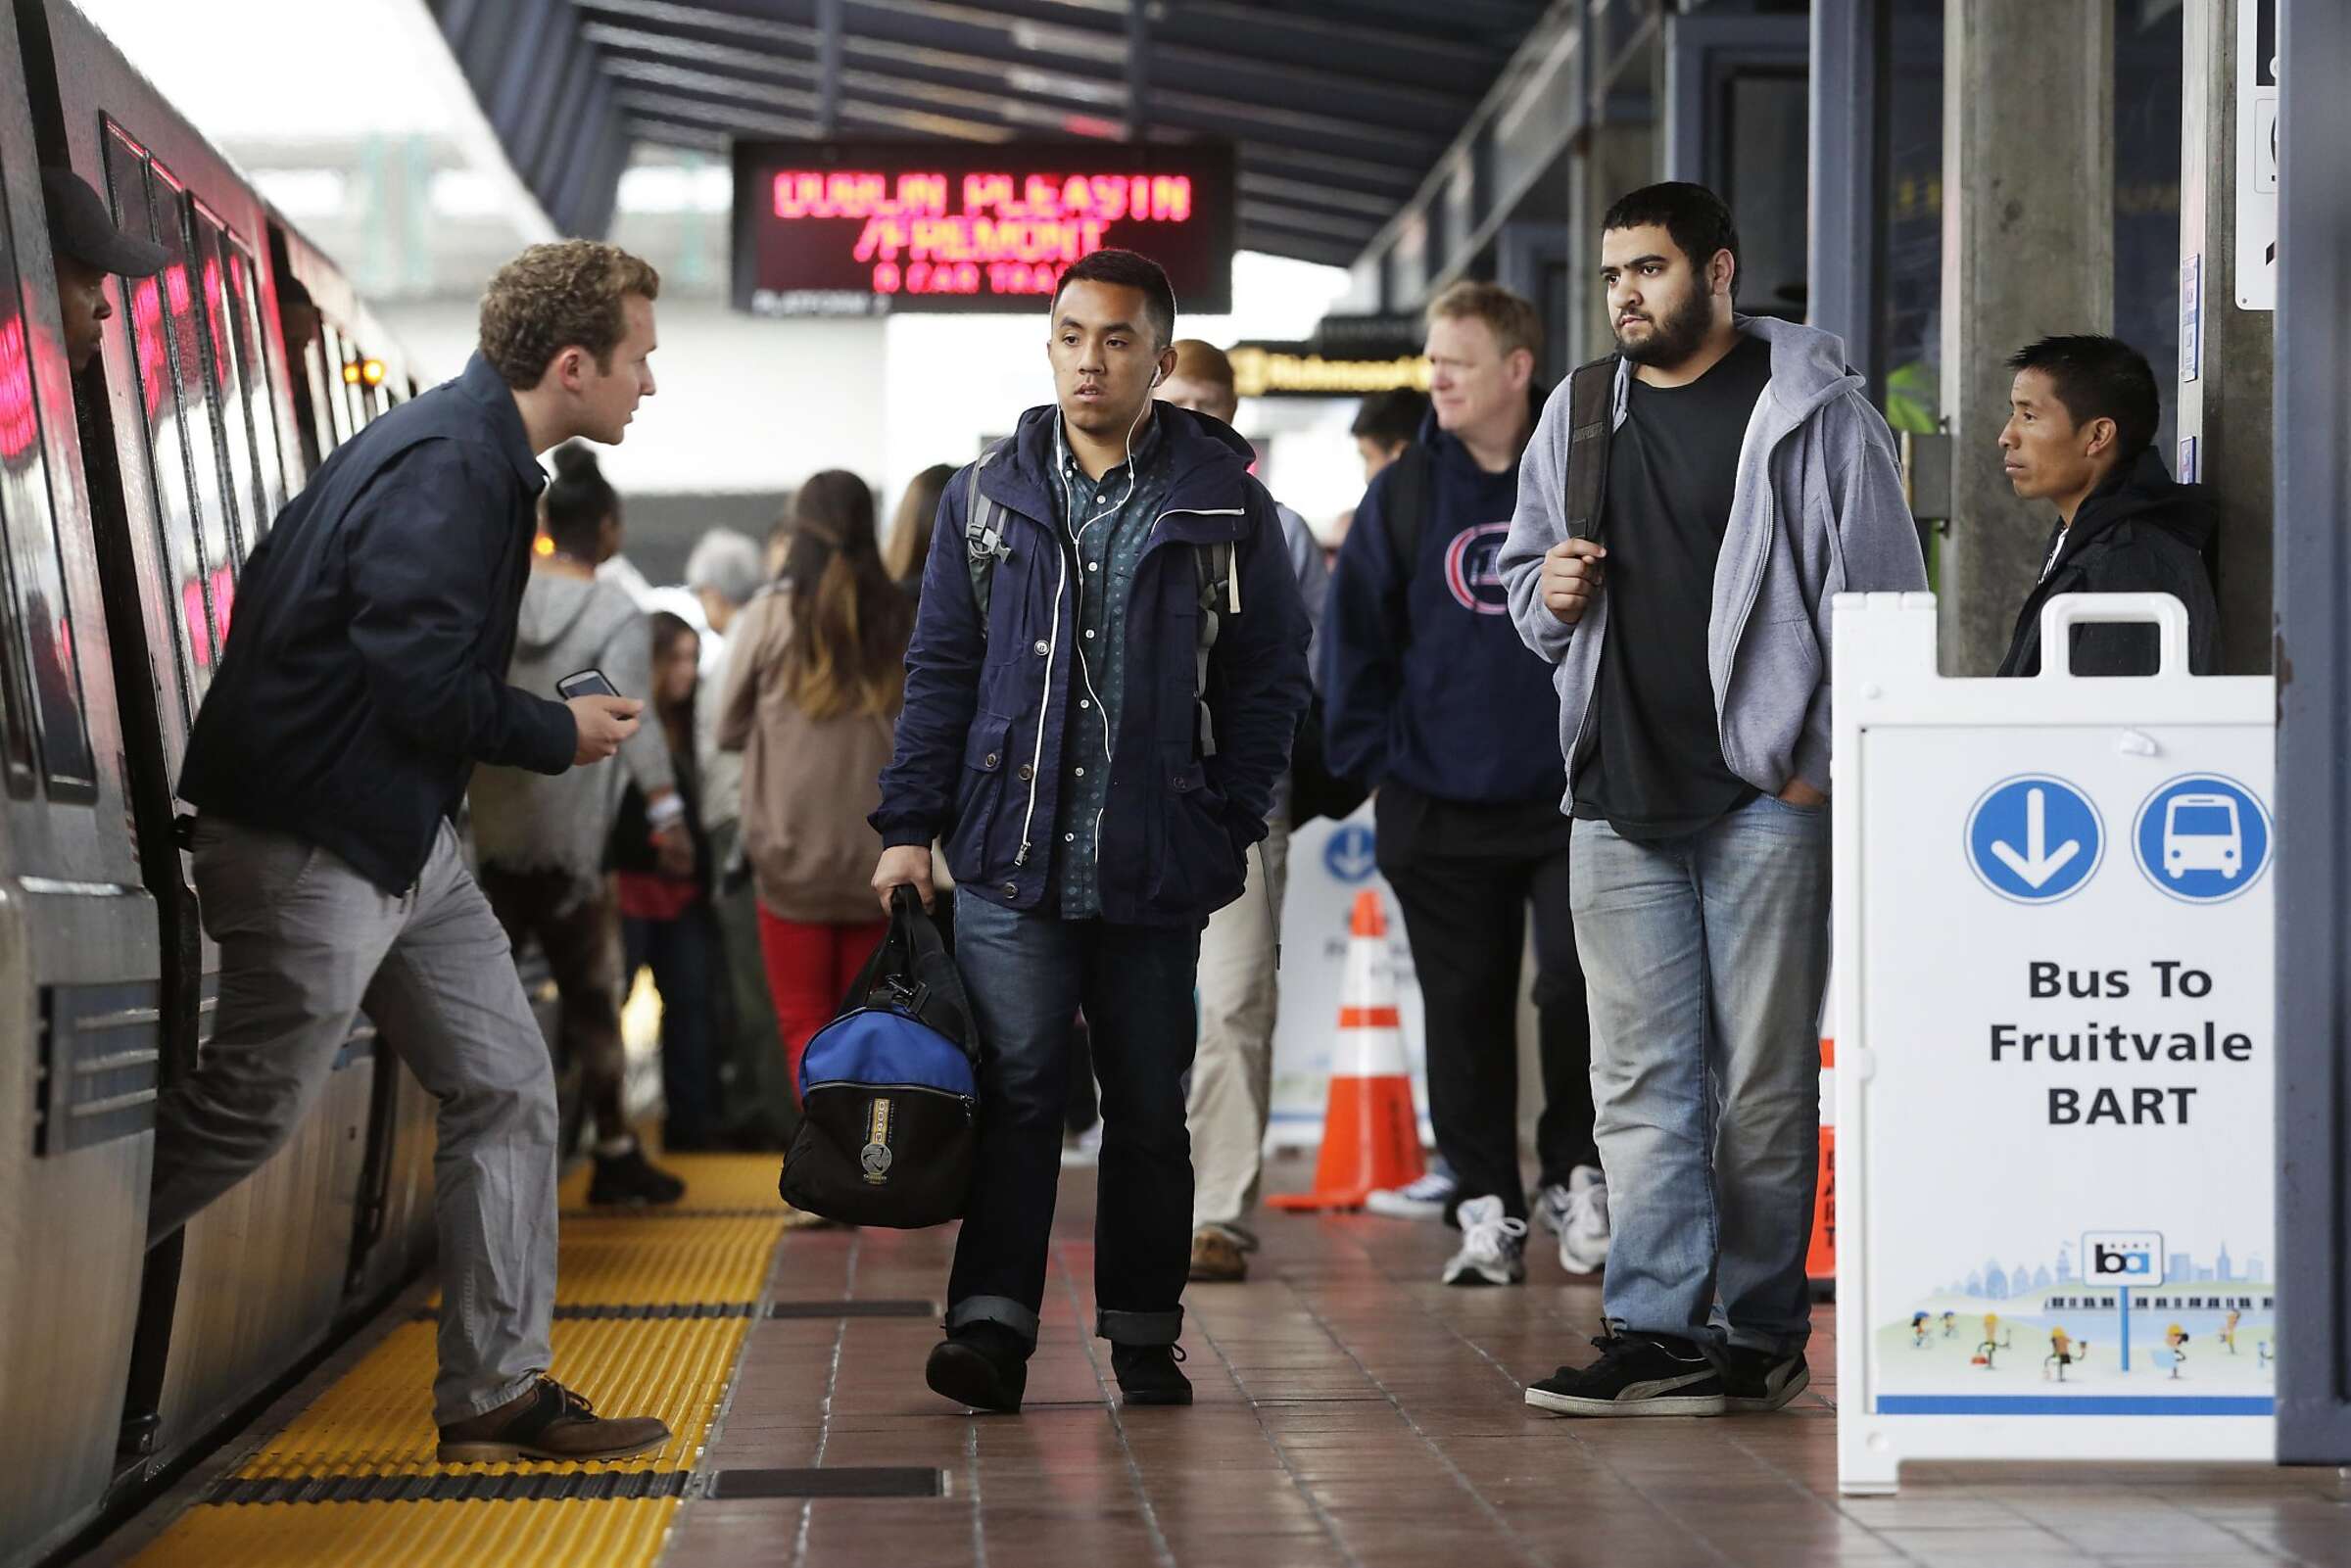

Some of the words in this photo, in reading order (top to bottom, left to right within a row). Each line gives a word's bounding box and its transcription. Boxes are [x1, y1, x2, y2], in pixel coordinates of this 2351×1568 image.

[2029, 961, 2131, 998] Bus
[2150, 961, 2212, 998] To
[1990, 1022, 2253, 1062] Fruitvale
[2047, 1087, 2197, 1125] BART
